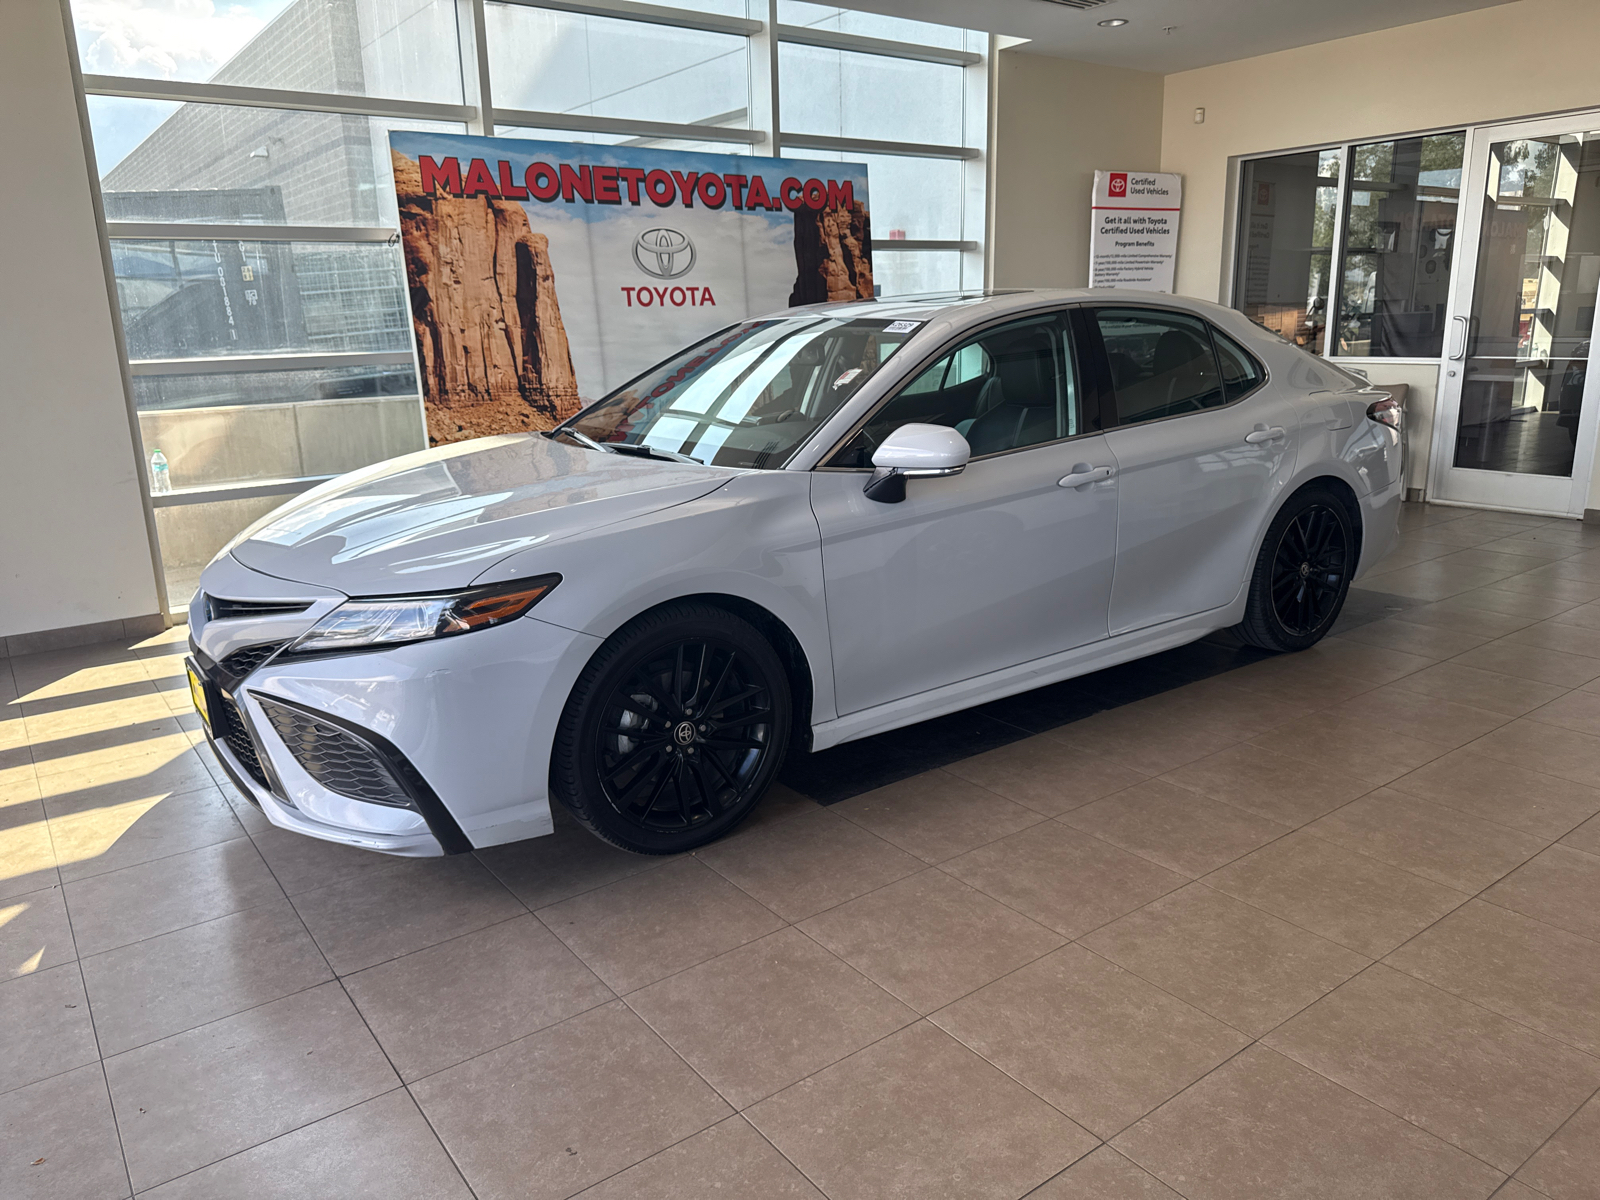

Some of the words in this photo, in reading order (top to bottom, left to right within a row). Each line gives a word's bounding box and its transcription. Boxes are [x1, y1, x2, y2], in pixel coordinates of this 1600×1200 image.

[418, 154, 855, 213] MALONETOYOTA.COM
[1130, 177, 1156, 186] Certified
[1130, 187, 1145, 195] Used
[1146, 187, 1169, 196] Vehicles
[1105, 216, 1116, 225] Get
[1117, 216, 1122, 225] it
[1123, 216, 1132, 225] all
[1132, 216, 1147, 225] with
[1147, 217, 1167, 226] Toyota
[1100, 226, 1128, 235] Certified
[1129, 226, 1145, 235] Used
[1145, 227, 1170, 235] Vehicles
[1115, 240, 1136, 249] Program
[621, 285, 717, 308] TOYOTA
